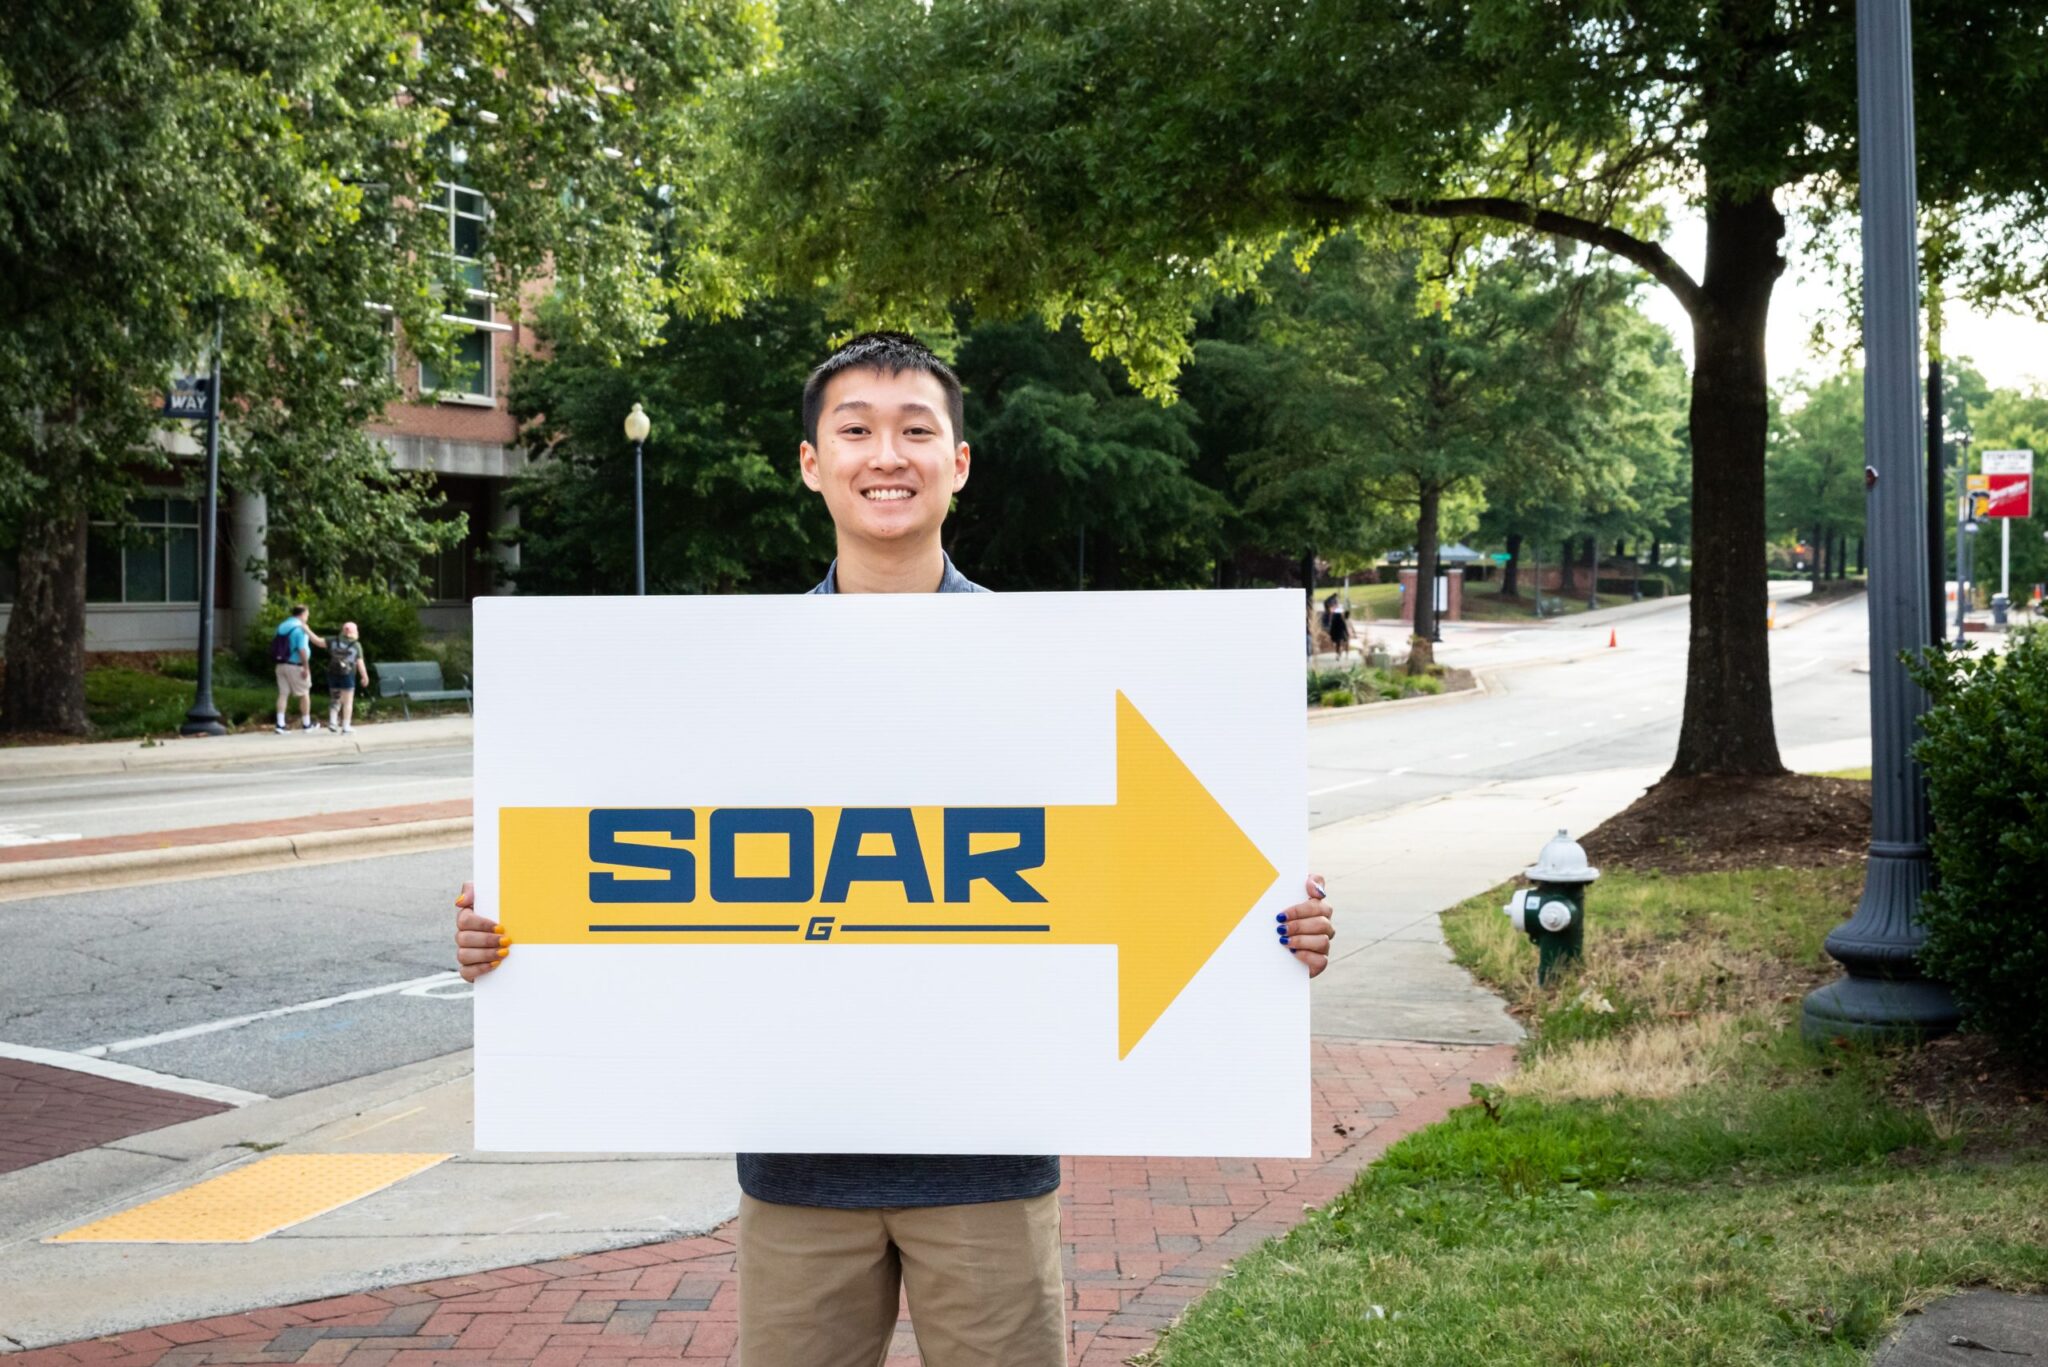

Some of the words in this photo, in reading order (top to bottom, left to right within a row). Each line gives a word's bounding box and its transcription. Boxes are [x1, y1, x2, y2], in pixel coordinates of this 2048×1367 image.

[171, 395, 207, 409] WAY
[589, 807, 1049, 903] SOAR
[805, 917, 836, 941] G
